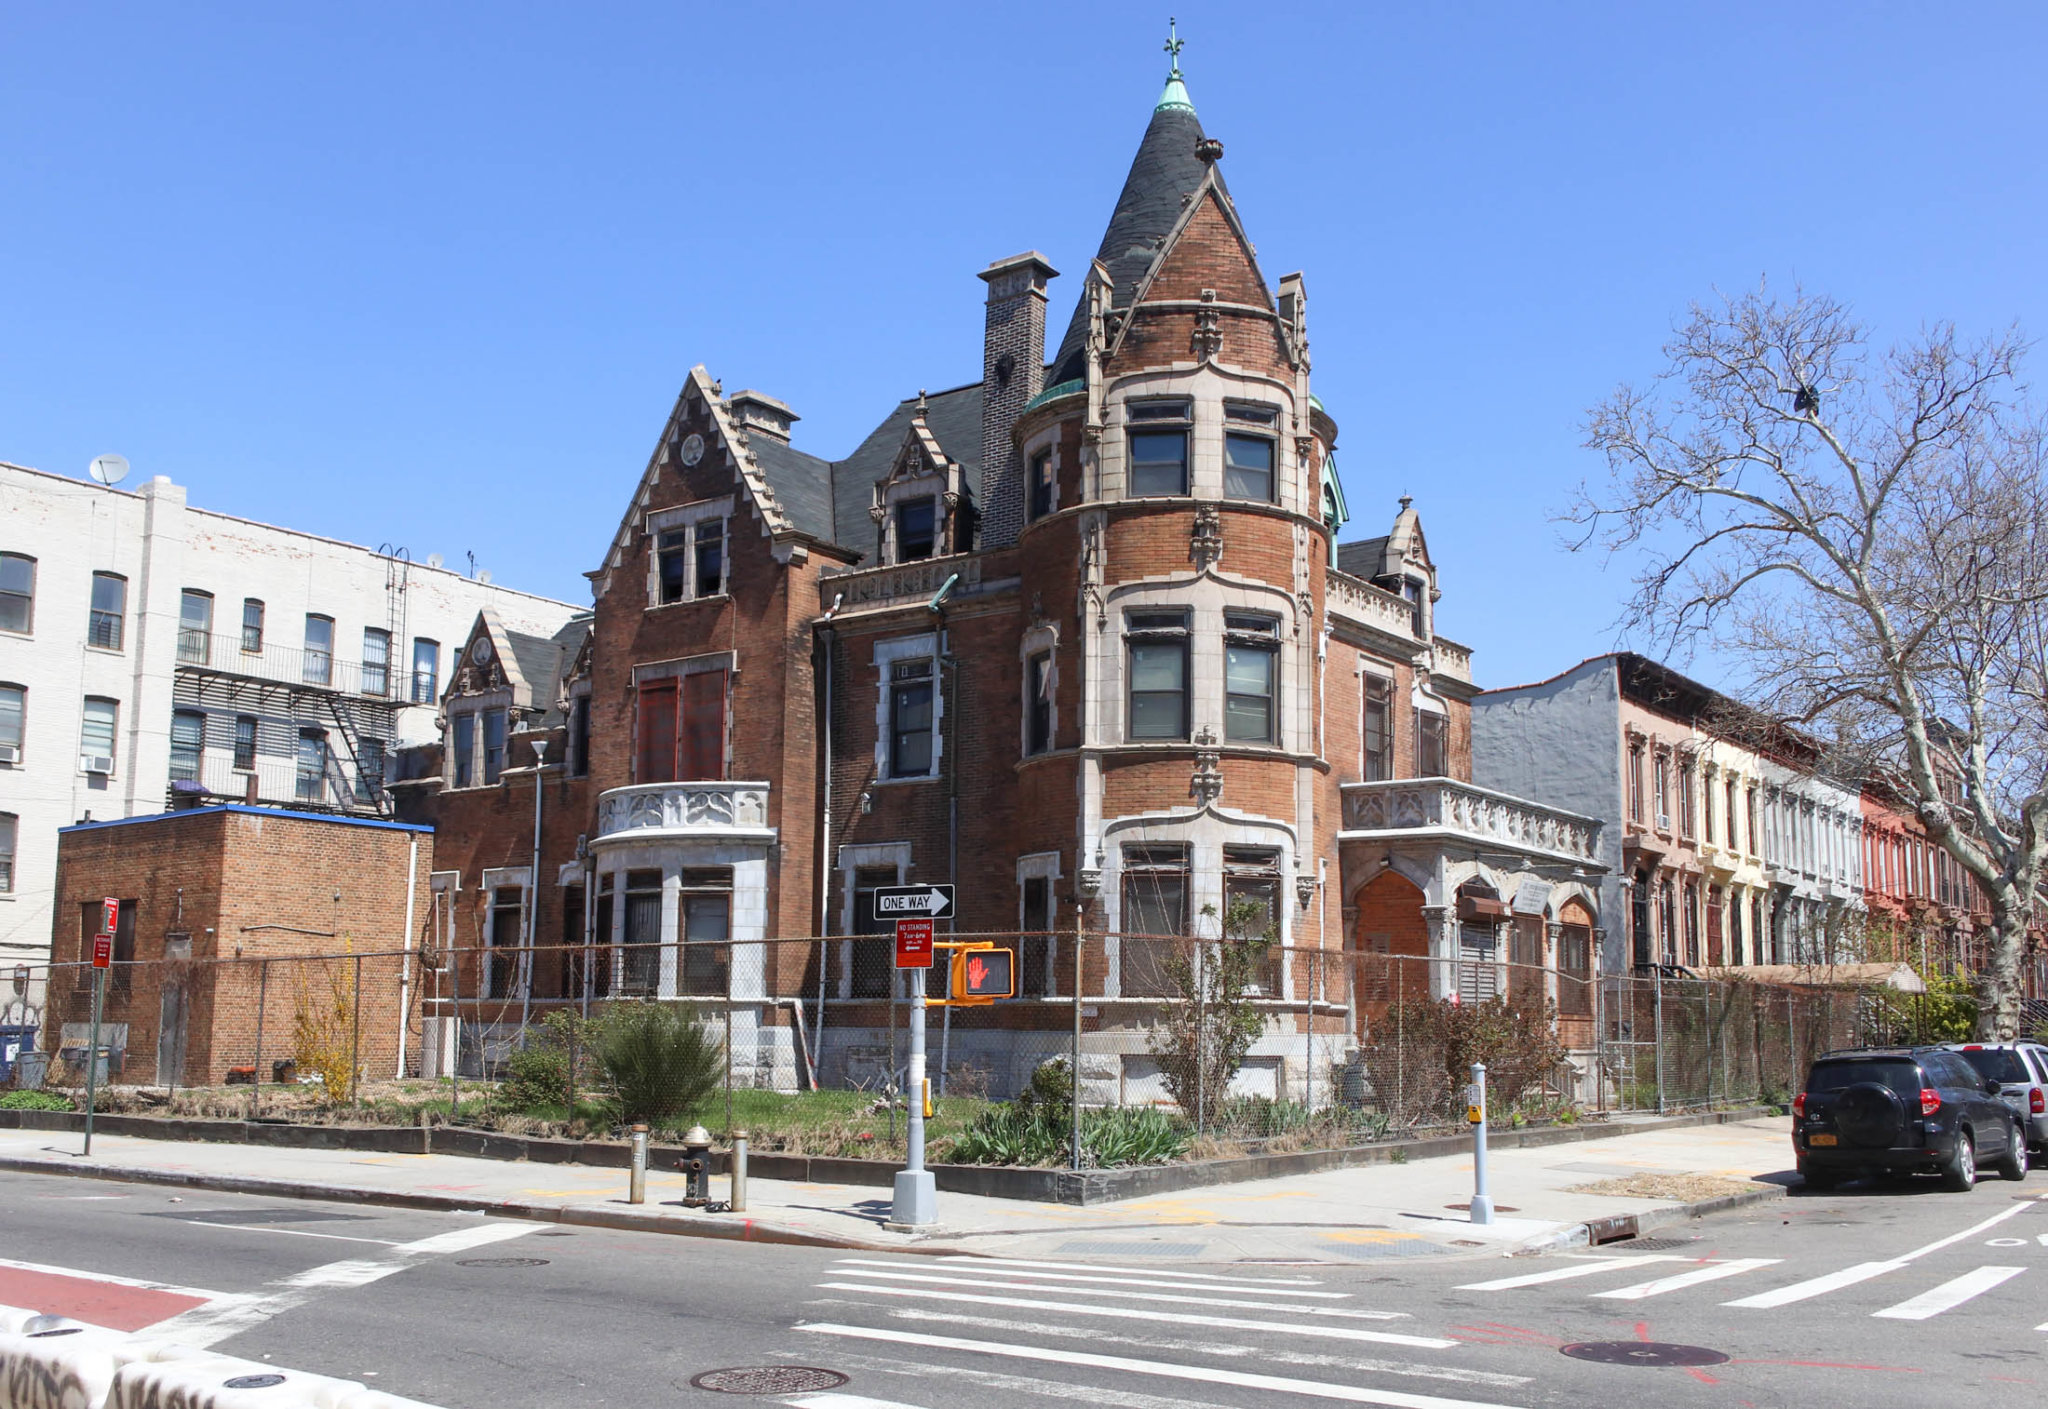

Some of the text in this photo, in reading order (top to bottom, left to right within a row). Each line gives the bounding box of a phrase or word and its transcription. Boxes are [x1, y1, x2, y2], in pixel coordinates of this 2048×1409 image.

[884, 896, 930, 909] ONE WAY
[907, 923, 930, 931] STANDING
